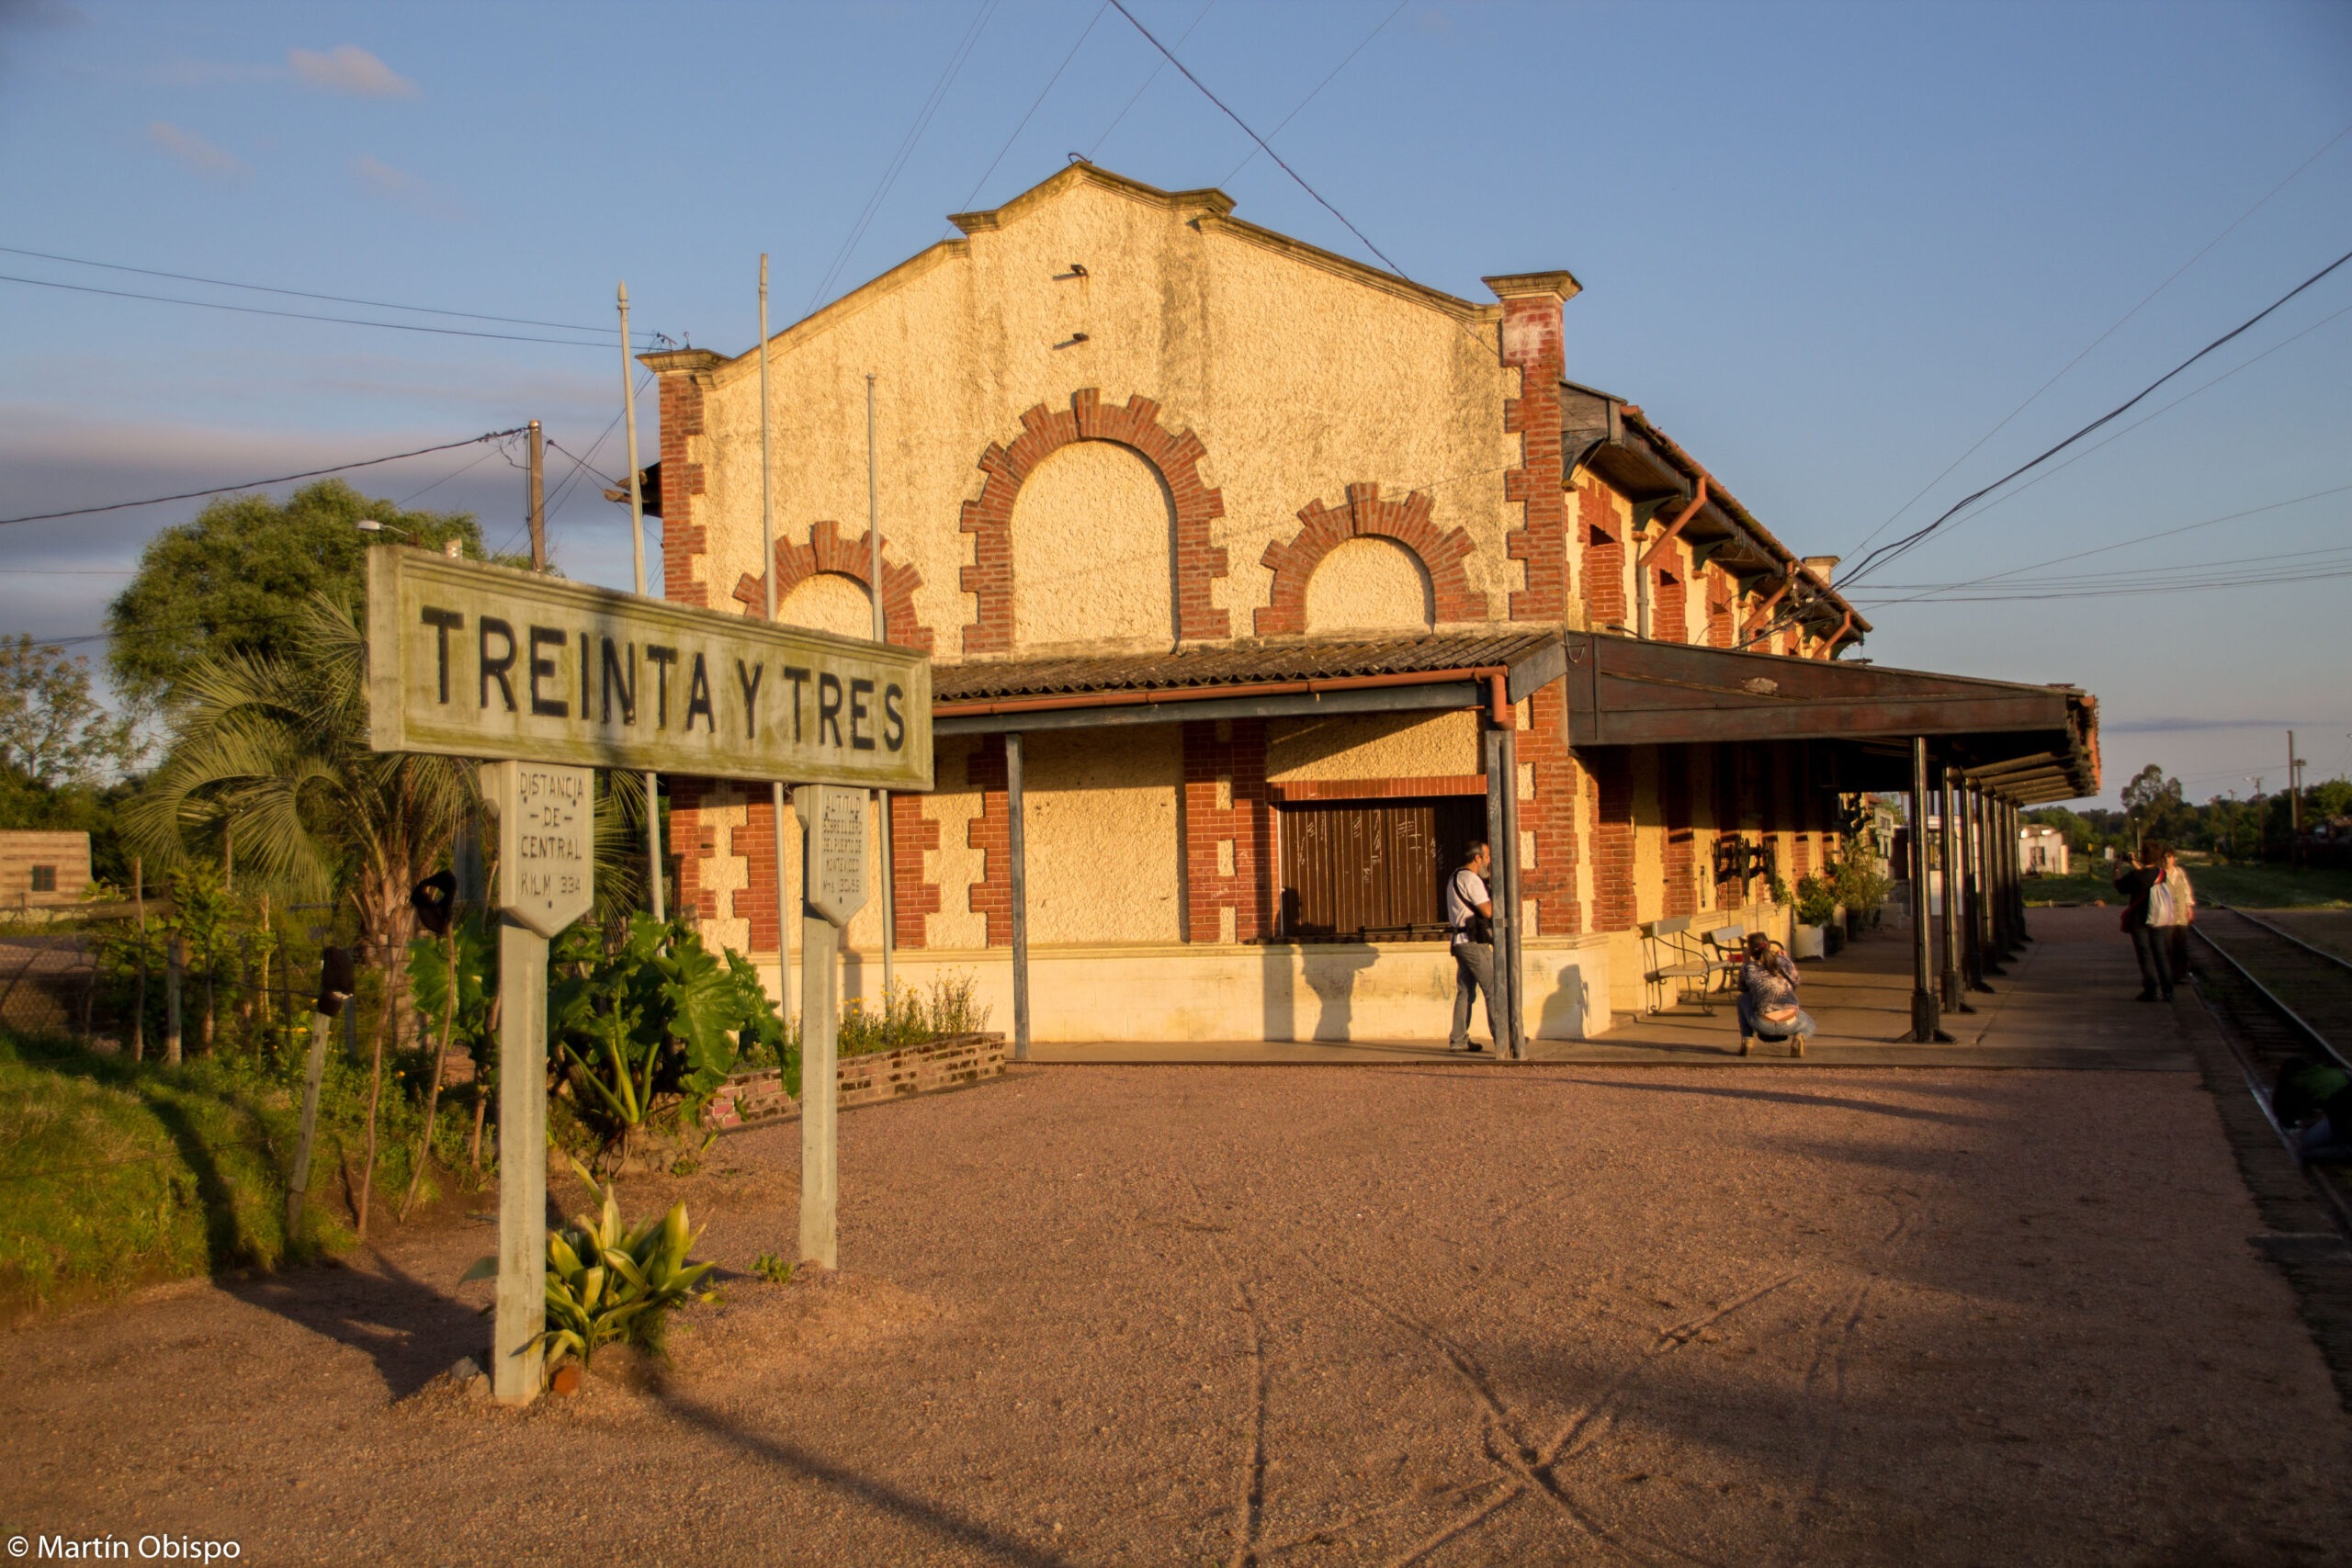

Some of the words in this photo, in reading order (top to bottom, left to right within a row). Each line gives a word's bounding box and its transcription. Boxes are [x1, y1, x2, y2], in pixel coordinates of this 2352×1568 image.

[421, 605, 716, 732] TREINTA
[737, 660, 764, 739] Y
[784, 666, 904, 751] TRES
[519, 773, 584, 799] DISTANCIA
[826, 795, 860, 814] ALTITUD
[521, 836, 582, 860] CENTRAL
[560, 876, 581, 894] 334
